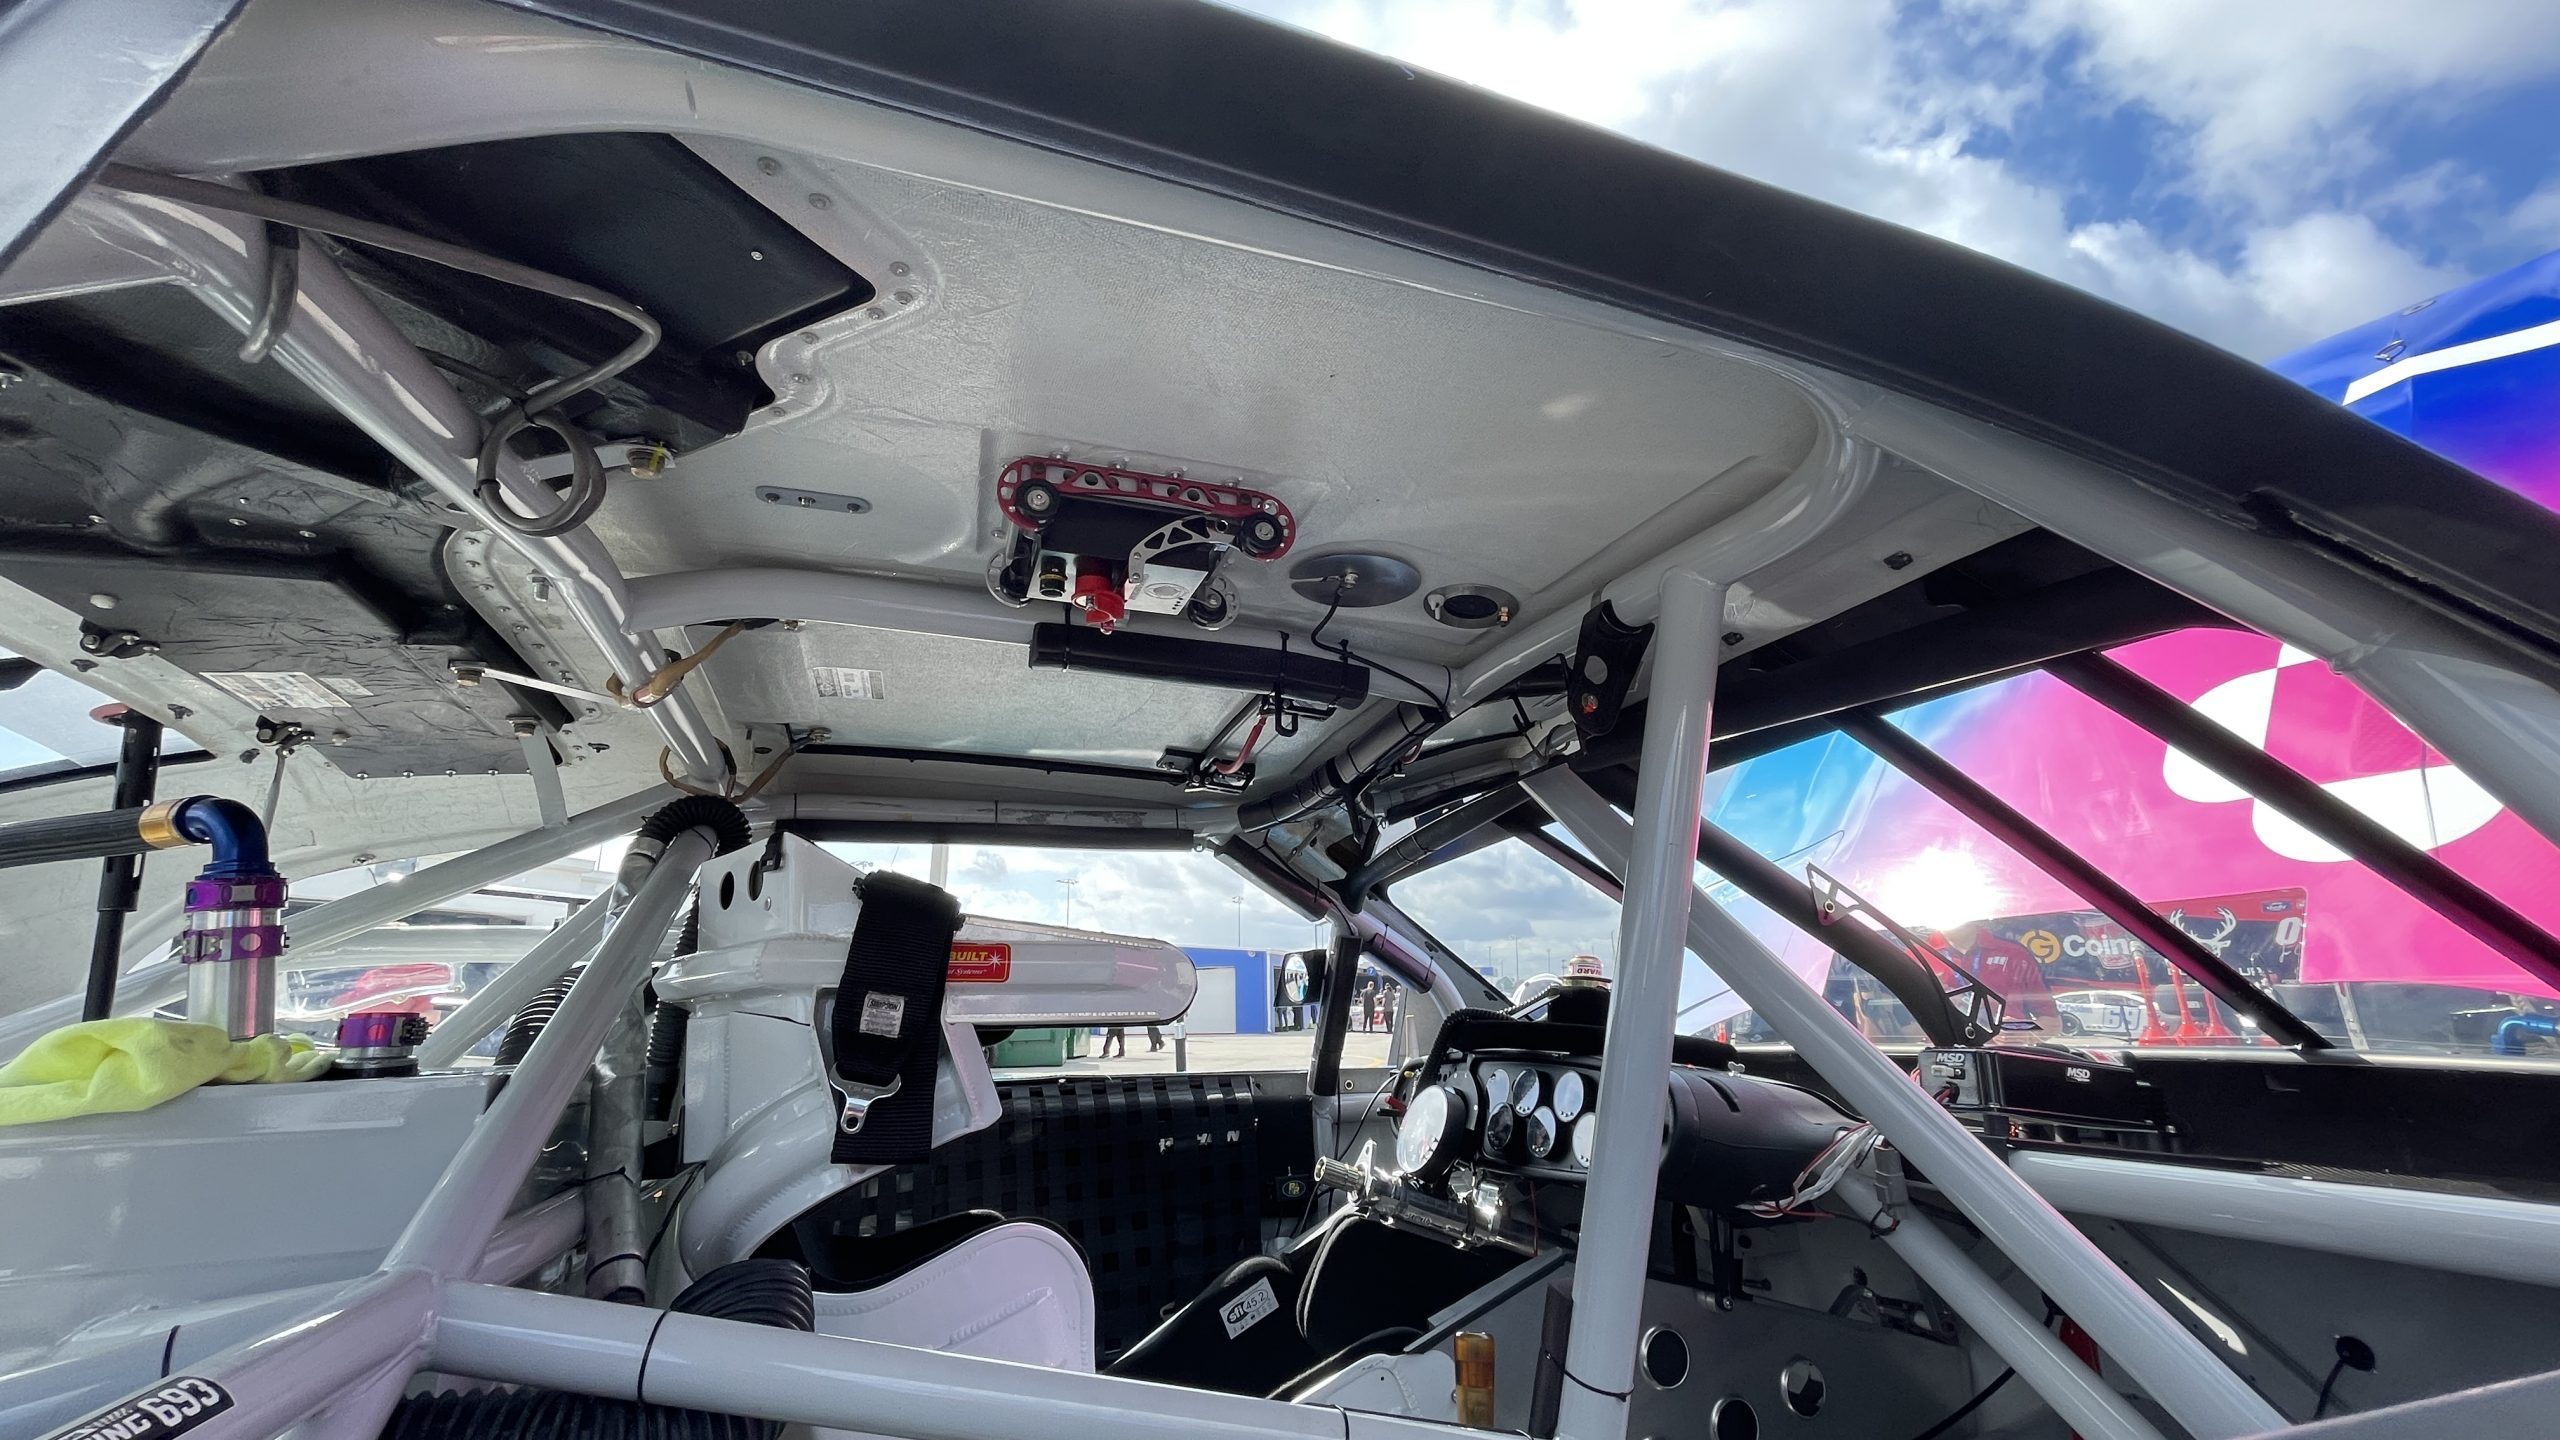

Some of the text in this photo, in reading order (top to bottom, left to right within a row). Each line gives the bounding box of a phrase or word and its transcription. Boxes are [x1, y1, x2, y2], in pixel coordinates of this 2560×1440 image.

[1936, 1053, 1965, 1063] MSD
[2066, 1067, 2091, 1079] MSD
[1228, 1304, 1245, 1322] sfi
[136, 1378, 220, 1428] 693
